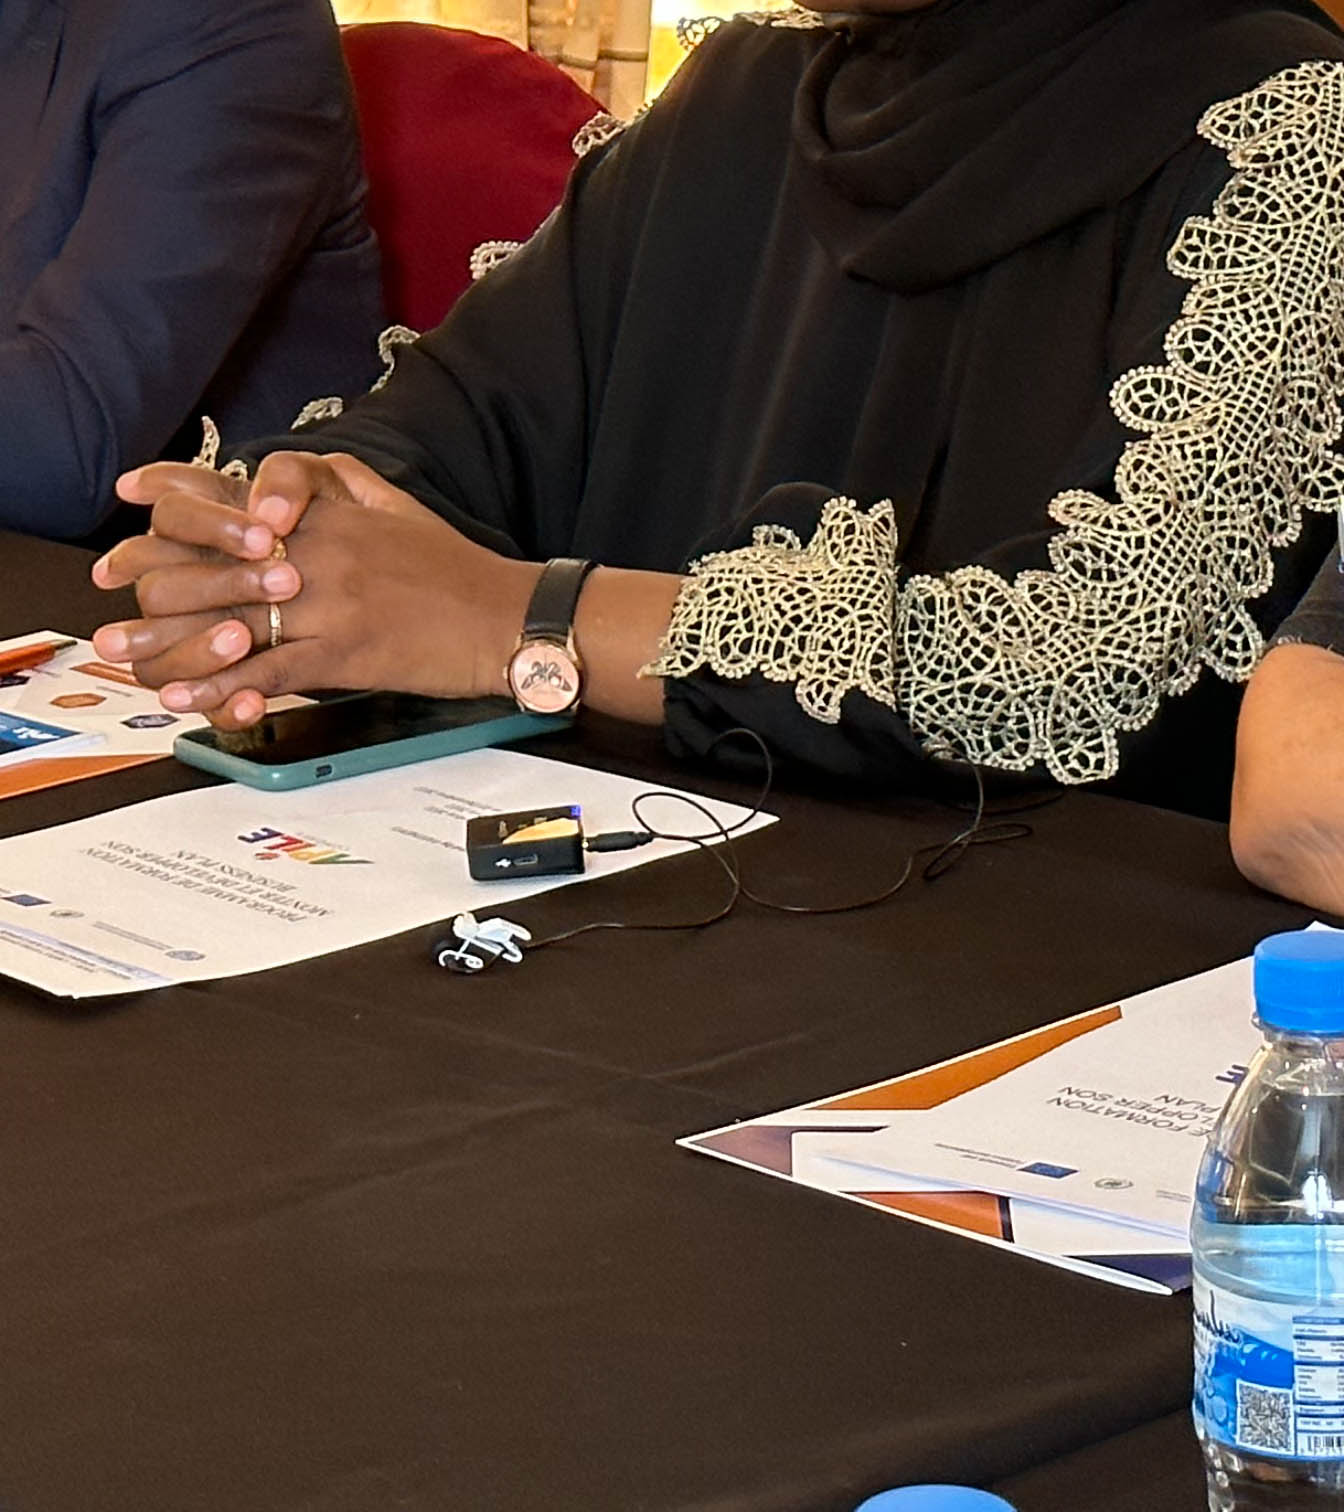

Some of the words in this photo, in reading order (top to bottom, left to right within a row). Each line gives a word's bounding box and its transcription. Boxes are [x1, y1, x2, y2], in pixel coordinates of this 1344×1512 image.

[82, 847, 176, 885] FORMATION
[1058, 1086, 1114, 1102] SON
[1154, 1094, 1224, 1114] PLAN
[1047, 1096, 1189, 1133] FORMATION
[1114, 1097, 1218, 1127] LOPPER
